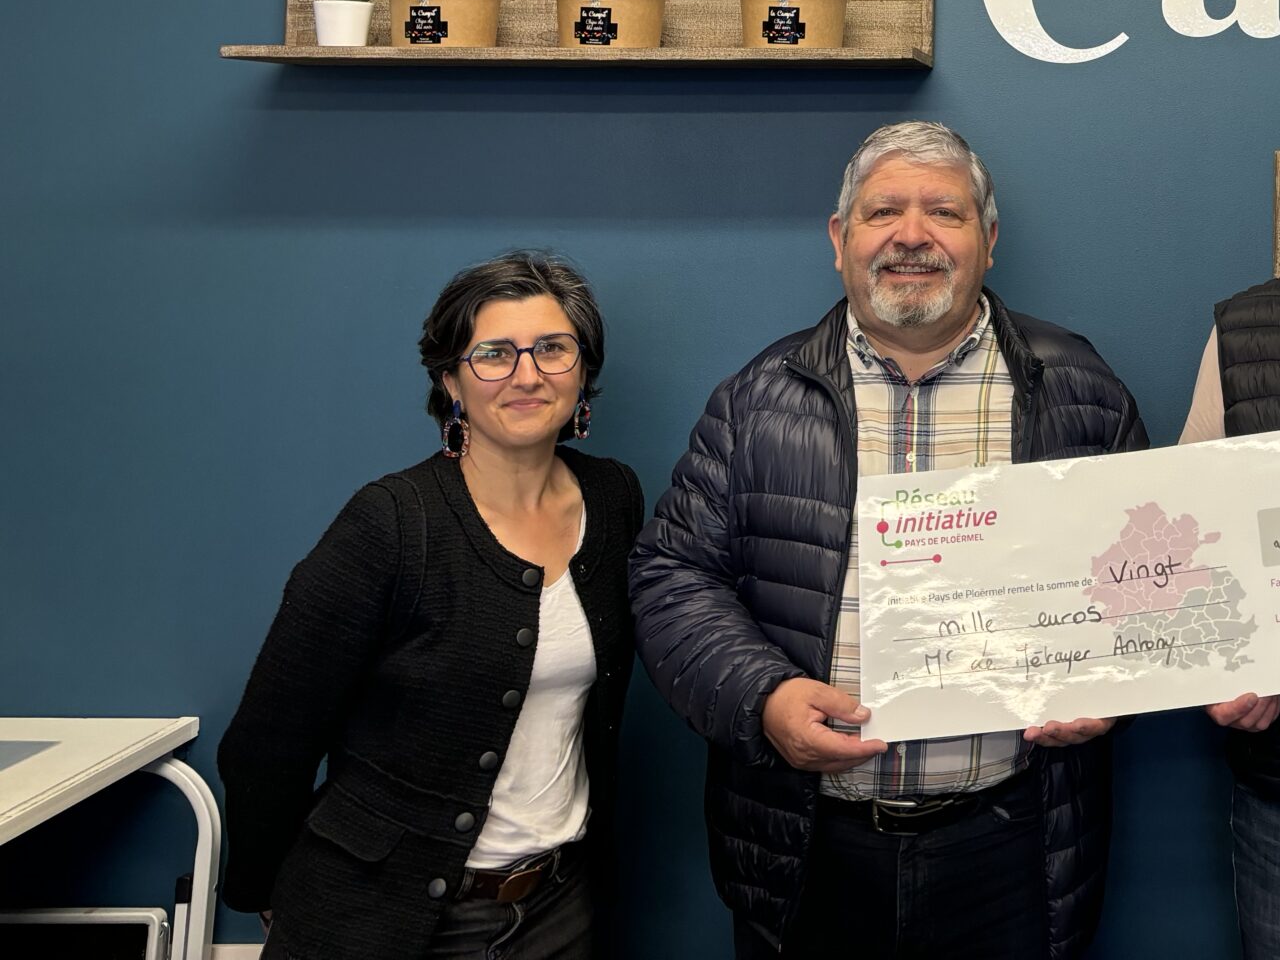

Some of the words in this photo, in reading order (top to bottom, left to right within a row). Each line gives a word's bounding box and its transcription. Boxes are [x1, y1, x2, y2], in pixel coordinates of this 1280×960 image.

[896, 488, 976, 508] Réseau
[896, 507, 997, 533] initiative
[905, 539, 926, 547] PAYS
[928, 537, 939, 545] DE
[941, 533, 984, 544] PLOËRMEL
[1109, 555, 1182, 588] Vingt
[929, 593, 950, 603] Pays
[953, 591, 963, 600] de
[966, 586, 1005, 599] Ploërmel
[1007, 584, 1034, 594] remet
[1036, 582, 1044, 591] la
[1046, 580, 1079, 590] somme
[939, 610, 995, 637] mille
[1029, 606, 1102, 628] euros
